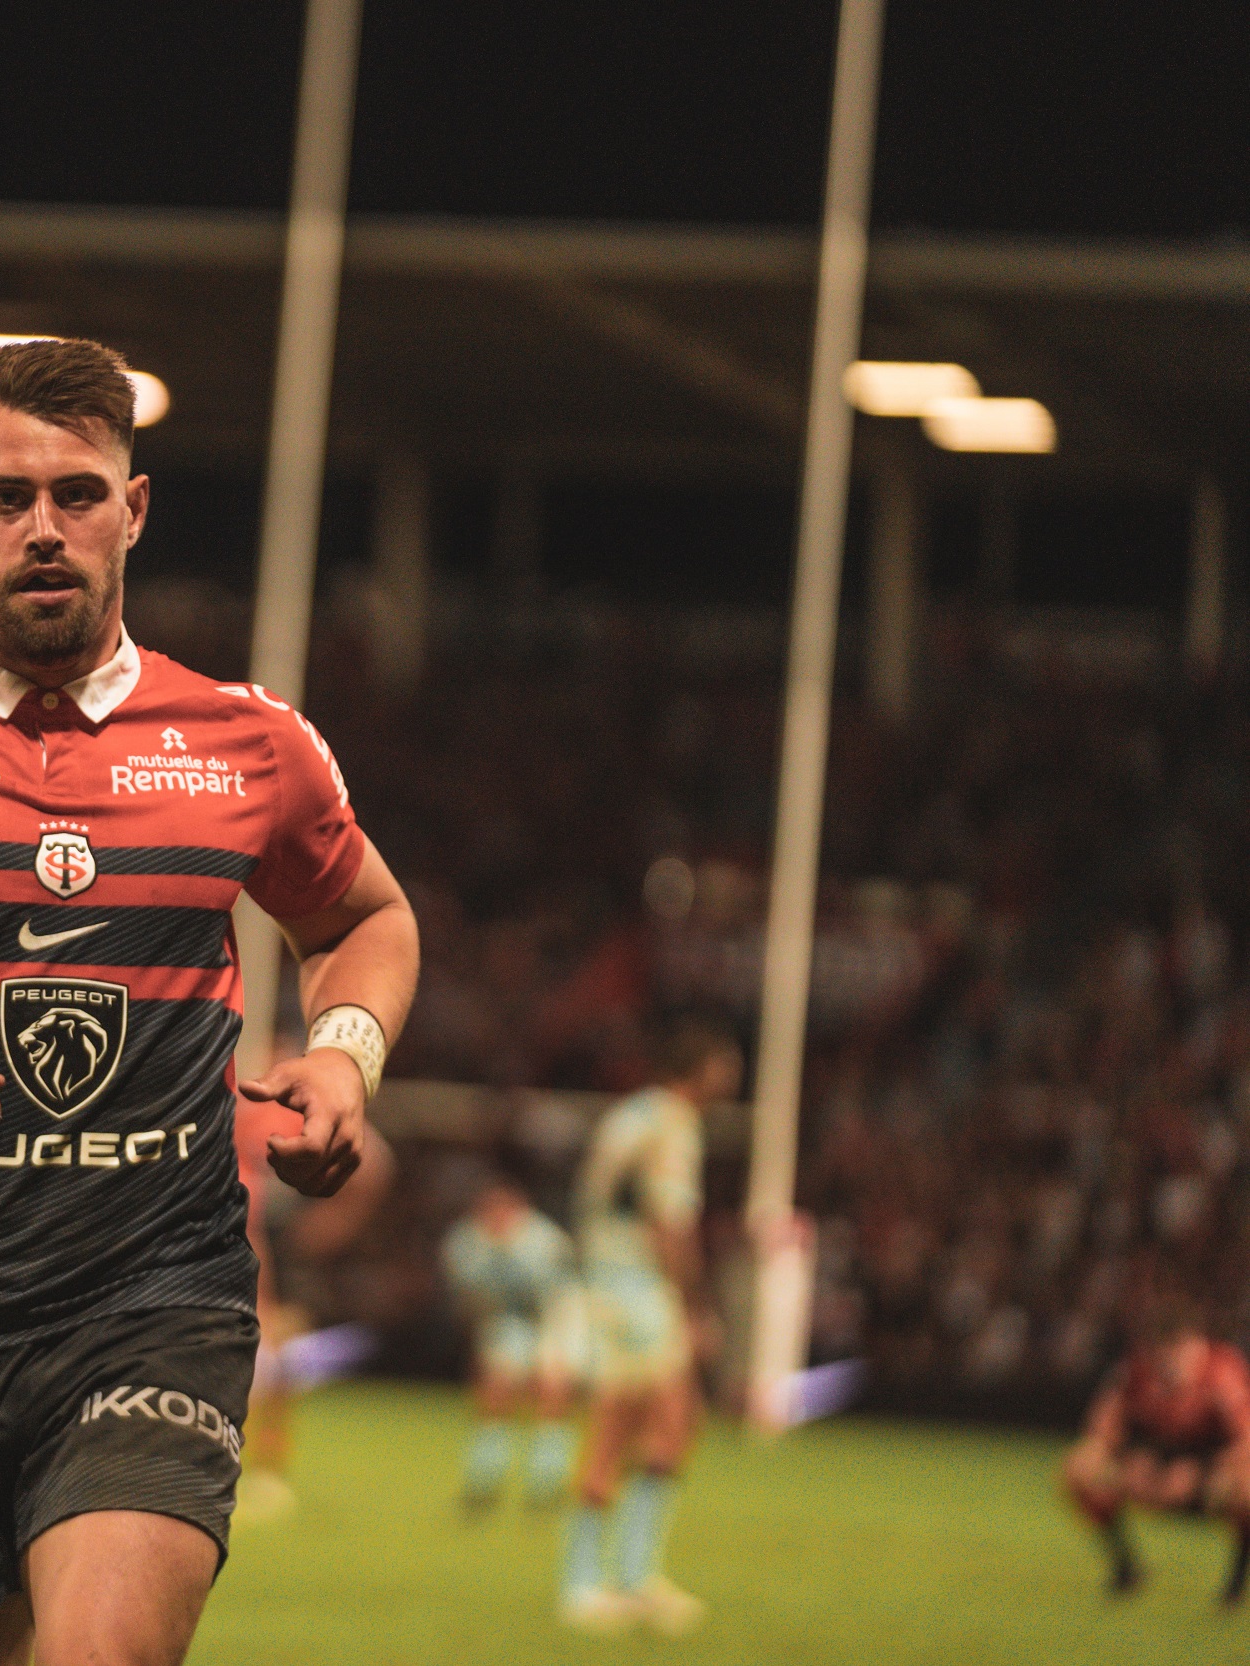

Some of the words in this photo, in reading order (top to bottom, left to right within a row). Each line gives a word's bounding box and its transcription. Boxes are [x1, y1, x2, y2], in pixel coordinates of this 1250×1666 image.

[127, 754, 204, 770] mutuelle
[206, 756, 229, 771] du
[111, 765, 247, 797] Rempart
[12, 988, 117, 1006] PEUGEOT
